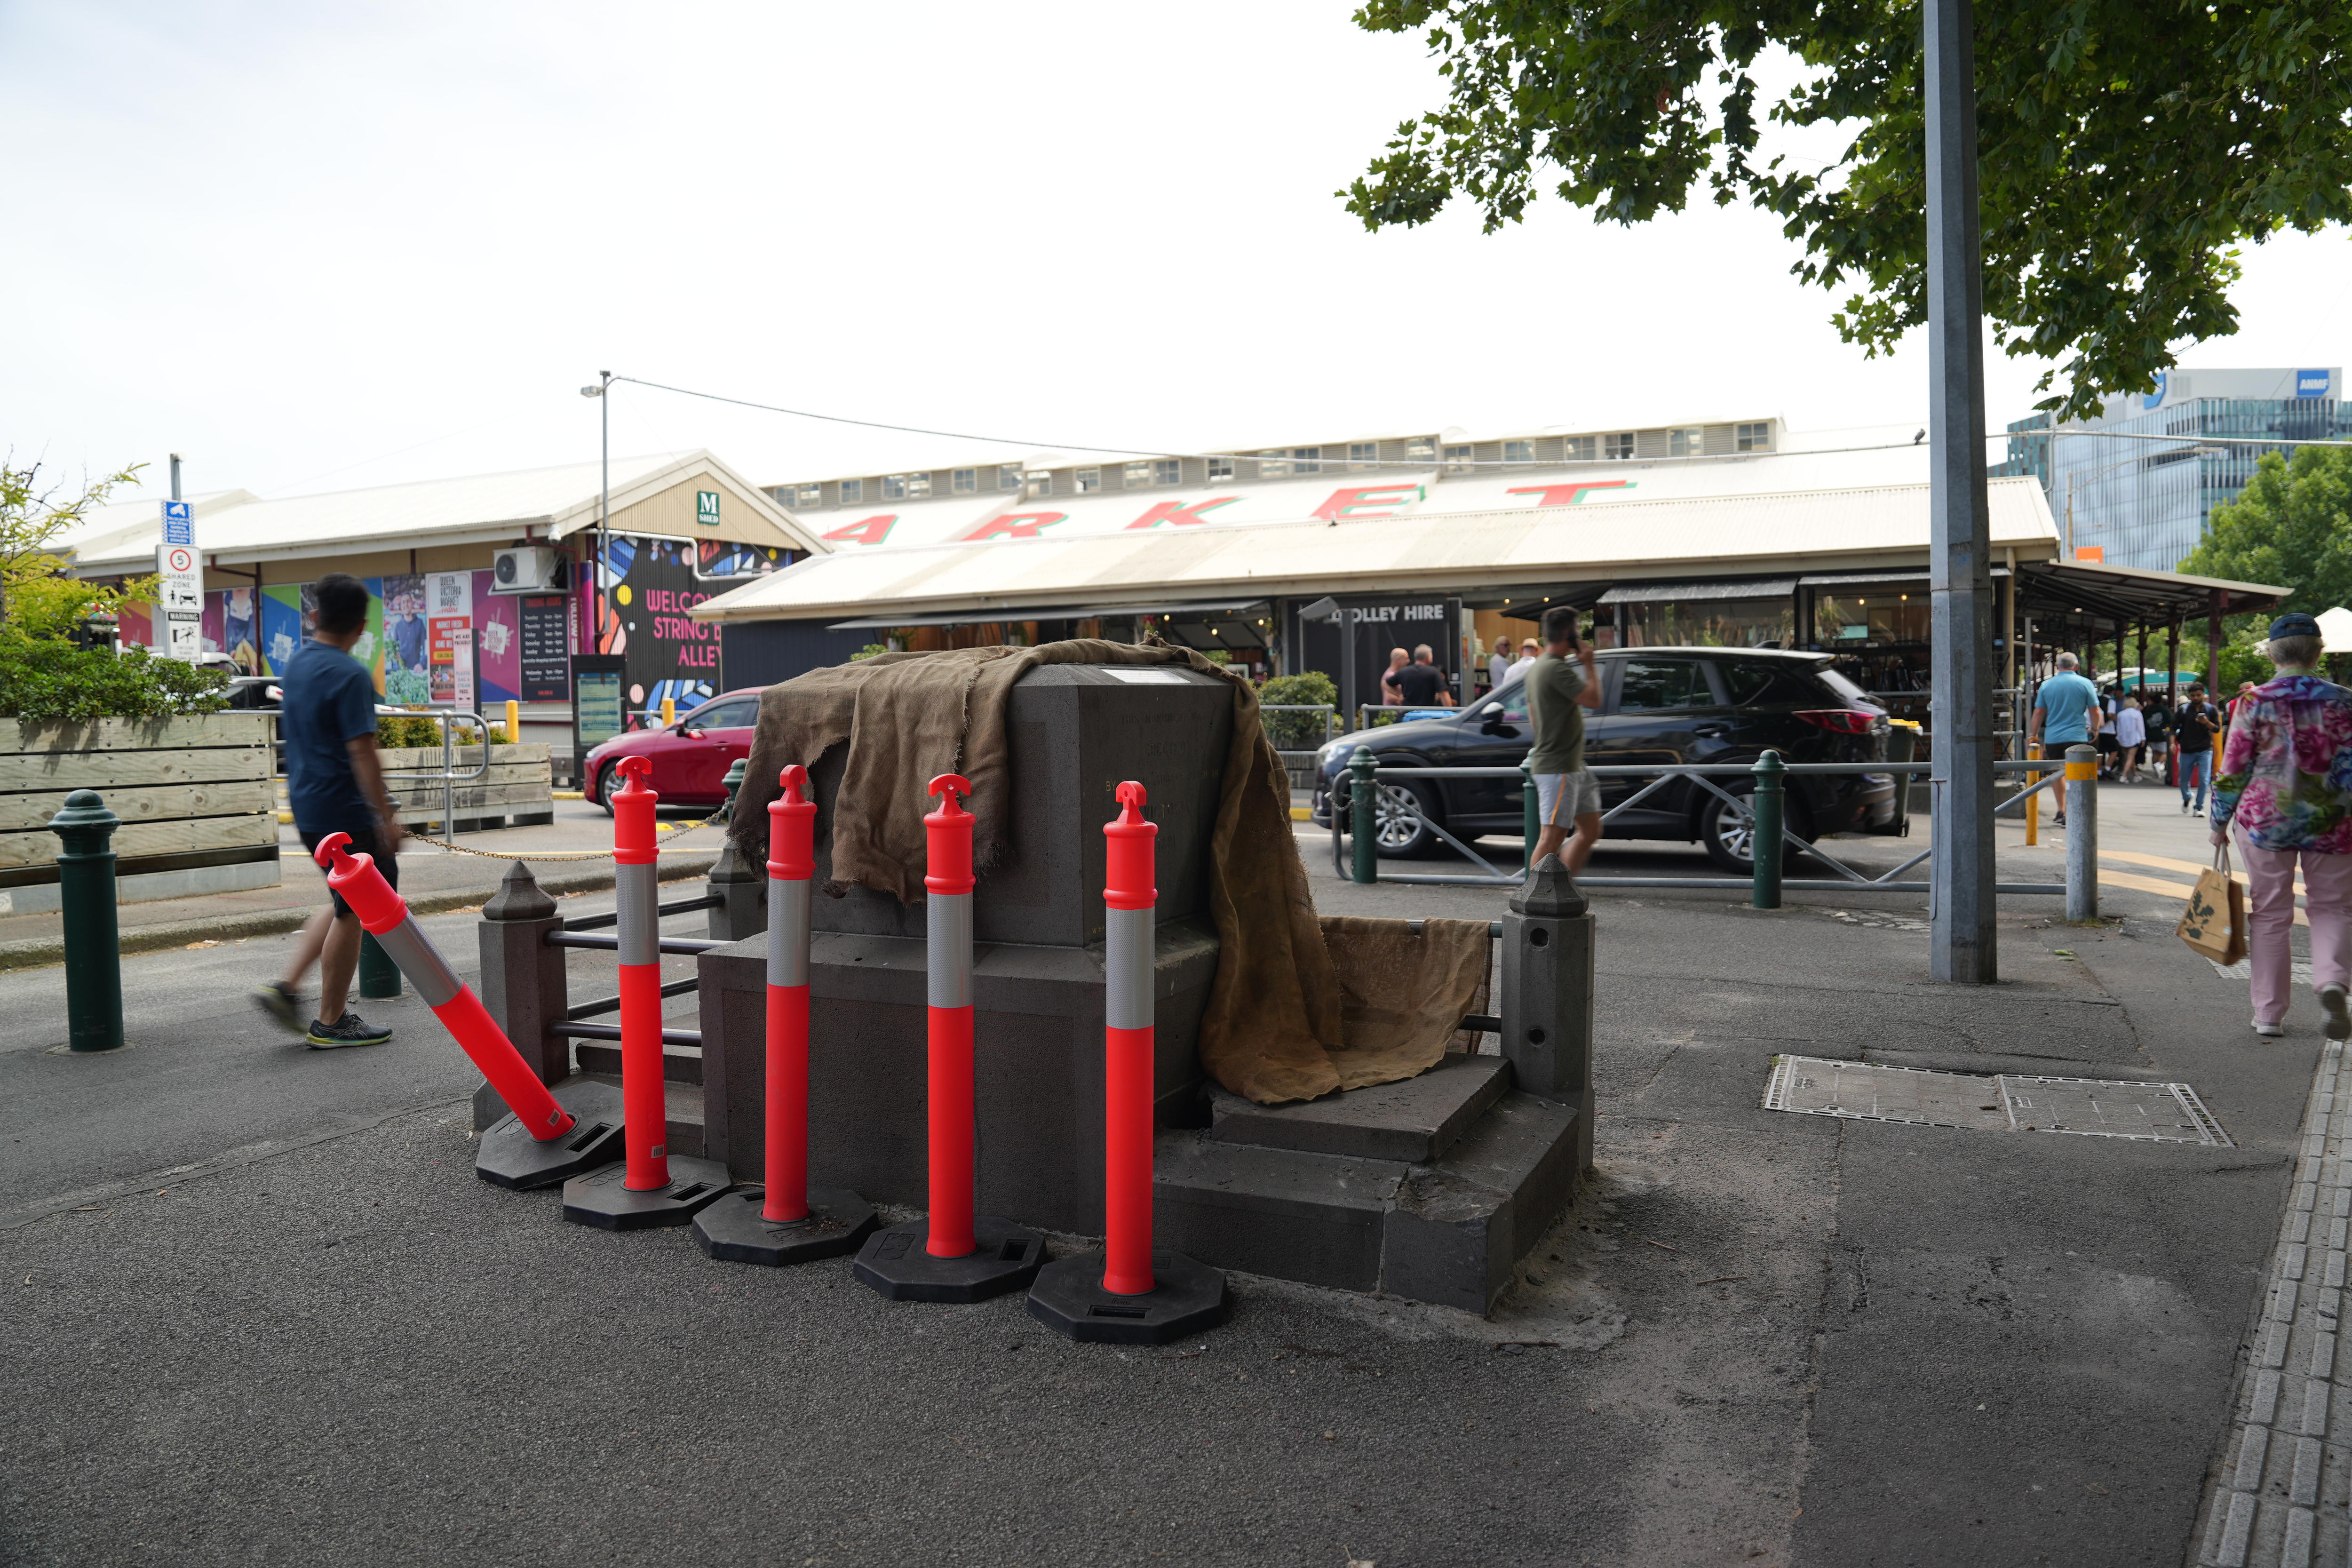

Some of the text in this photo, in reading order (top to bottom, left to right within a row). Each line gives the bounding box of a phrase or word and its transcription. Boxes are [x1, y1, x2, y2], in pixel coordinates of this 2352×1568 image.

[2299, 378, 2328, 390] ANMF
[699, 492, 718, 514] M
[699, 514, 718, 523] SHED
[177, 556, 184, 565] 5
[440, 576, 455, 586] QUEEN
[440, 586, 462, 596] VICTORIA
[440, 596, 459, 606] MARKET
[646, 589, 720, 613] WELCO
[1331, 605, 1444, 622] OLLEY HIRE
[653, 616, 708, 641] STRING
[1106, 780, 1116, 791] BY
